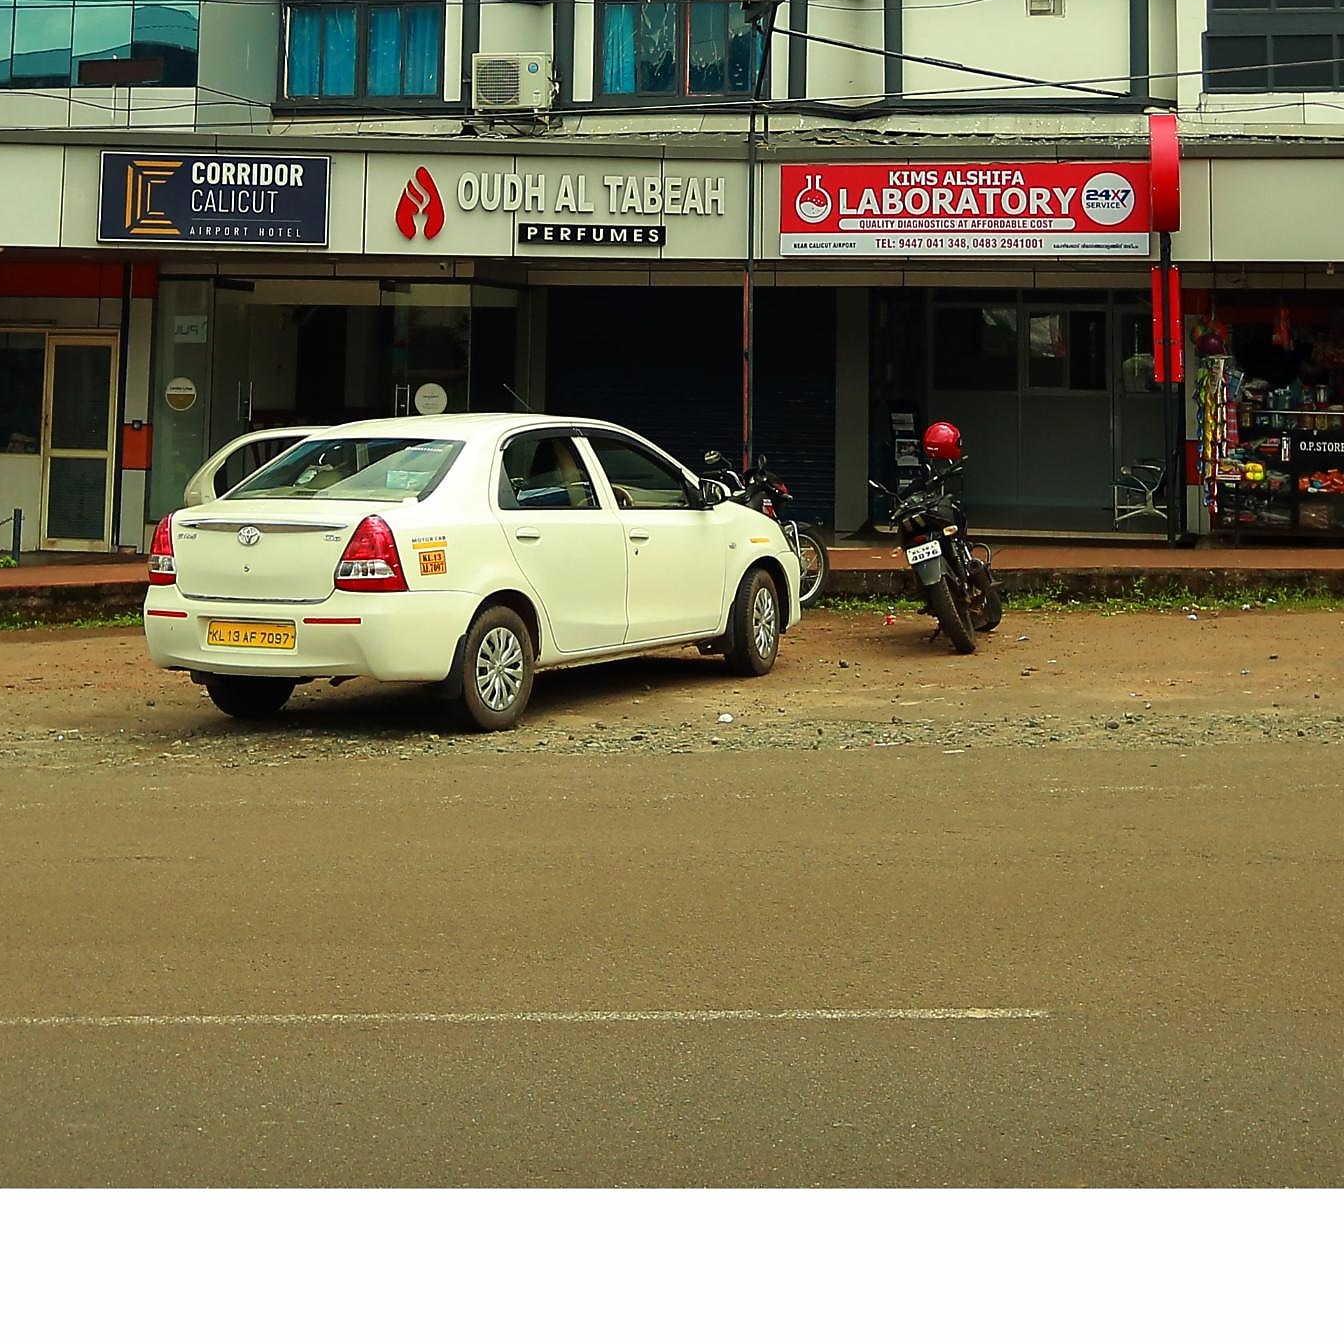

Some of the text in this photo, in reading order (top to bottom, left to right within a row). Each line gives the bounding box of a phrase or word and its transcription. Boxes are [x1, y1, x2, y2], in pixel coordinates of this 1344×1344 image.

[191, 162, 304, 187] CORRIDOR
[888, 170, 1025, 186] KIMS ALSHIFA
[191, 189, 279, 214] CALICUT
[457, 172, 726, 216] OUDH AL TABEAH
[839, 187, 1076, 215] LABORATORY
[1086, 201, 1120, 209] SERVICE
[189, 226, 301, 238] AIRPORT HOTEL
[859, 219, 1053, 229] QUALITY DIAGNOSTICS AT AFFORDABLE COST
[527, 227, 660, 244] PERFUMES
[875, 238, 896, 249] TEL:
[898, 238, 923, 249] 9447
[926, 238, 944, 249] 041
[972, 238, 1000, 249] 0483
[1001, 238, 1044, 249] 2941001
[211, 629, 290, 645] KL 13 AF 7097
